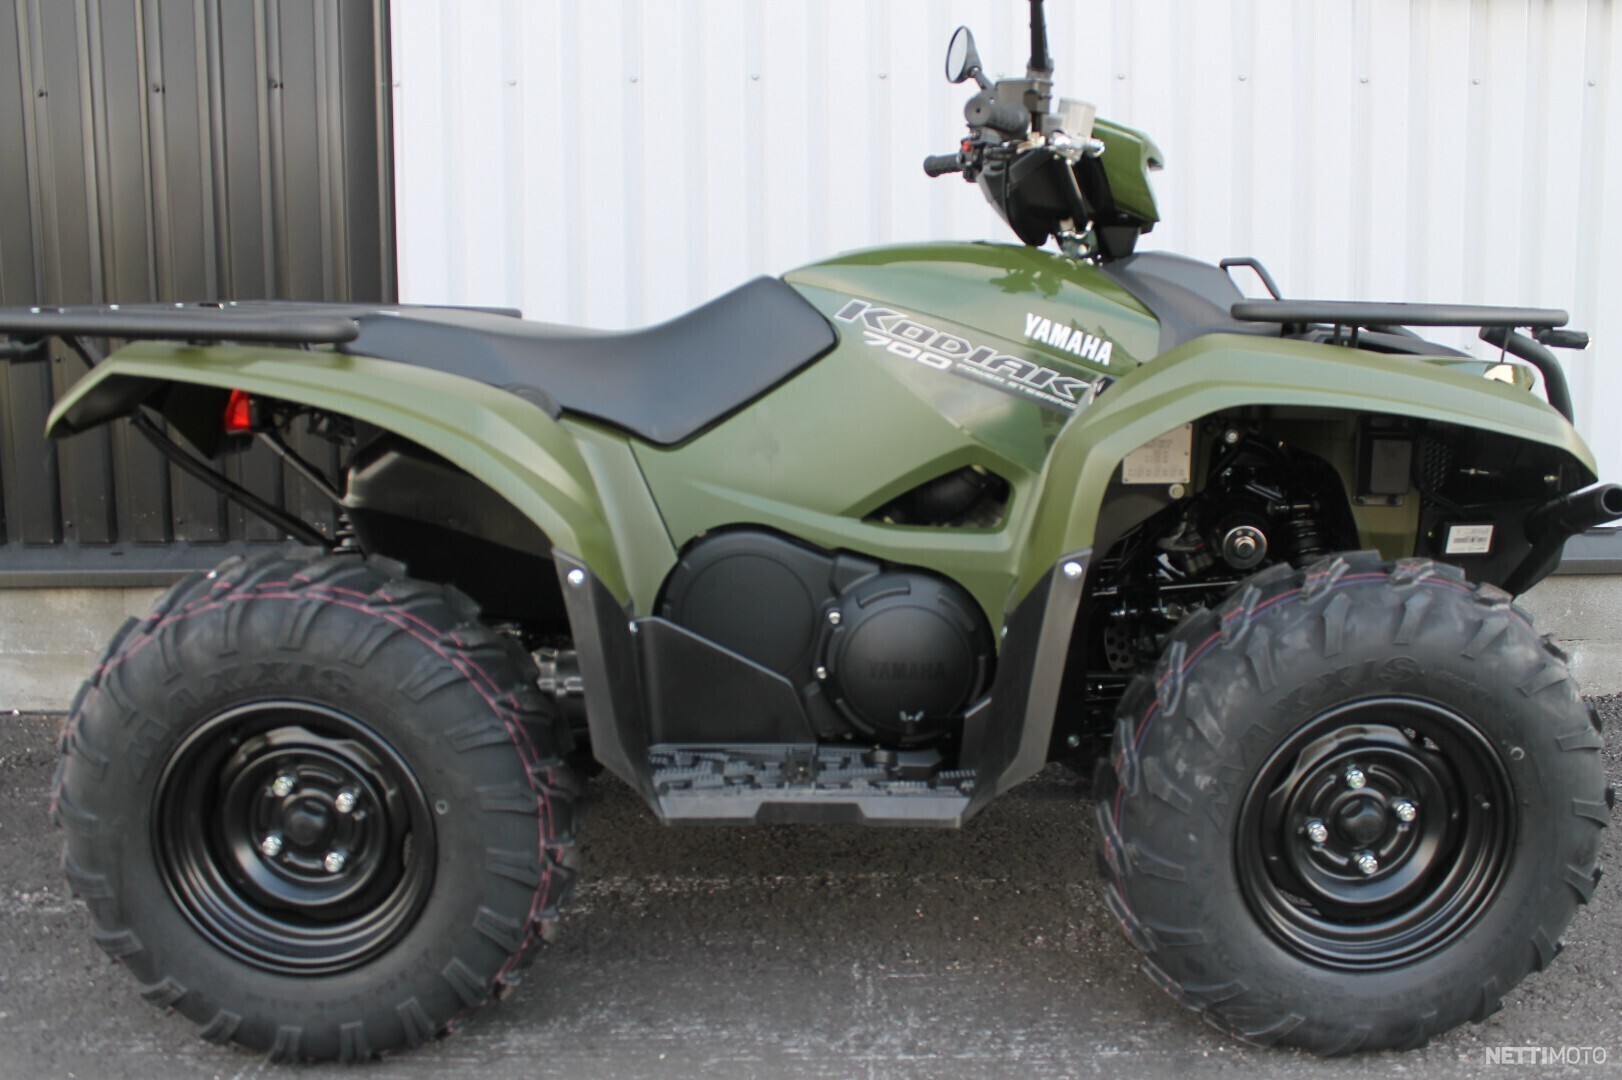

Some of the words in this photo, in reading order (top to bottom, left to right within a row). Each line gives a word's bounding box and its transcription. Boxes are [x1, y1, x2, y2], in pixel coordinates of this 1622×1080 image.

[833, 298, 1093, 402] KODIAK
[862, 330, 953, 370] 700
[1023, 312, 1112, 367] YAMAHA
[868, 661, 945, 681] YAMAHA
